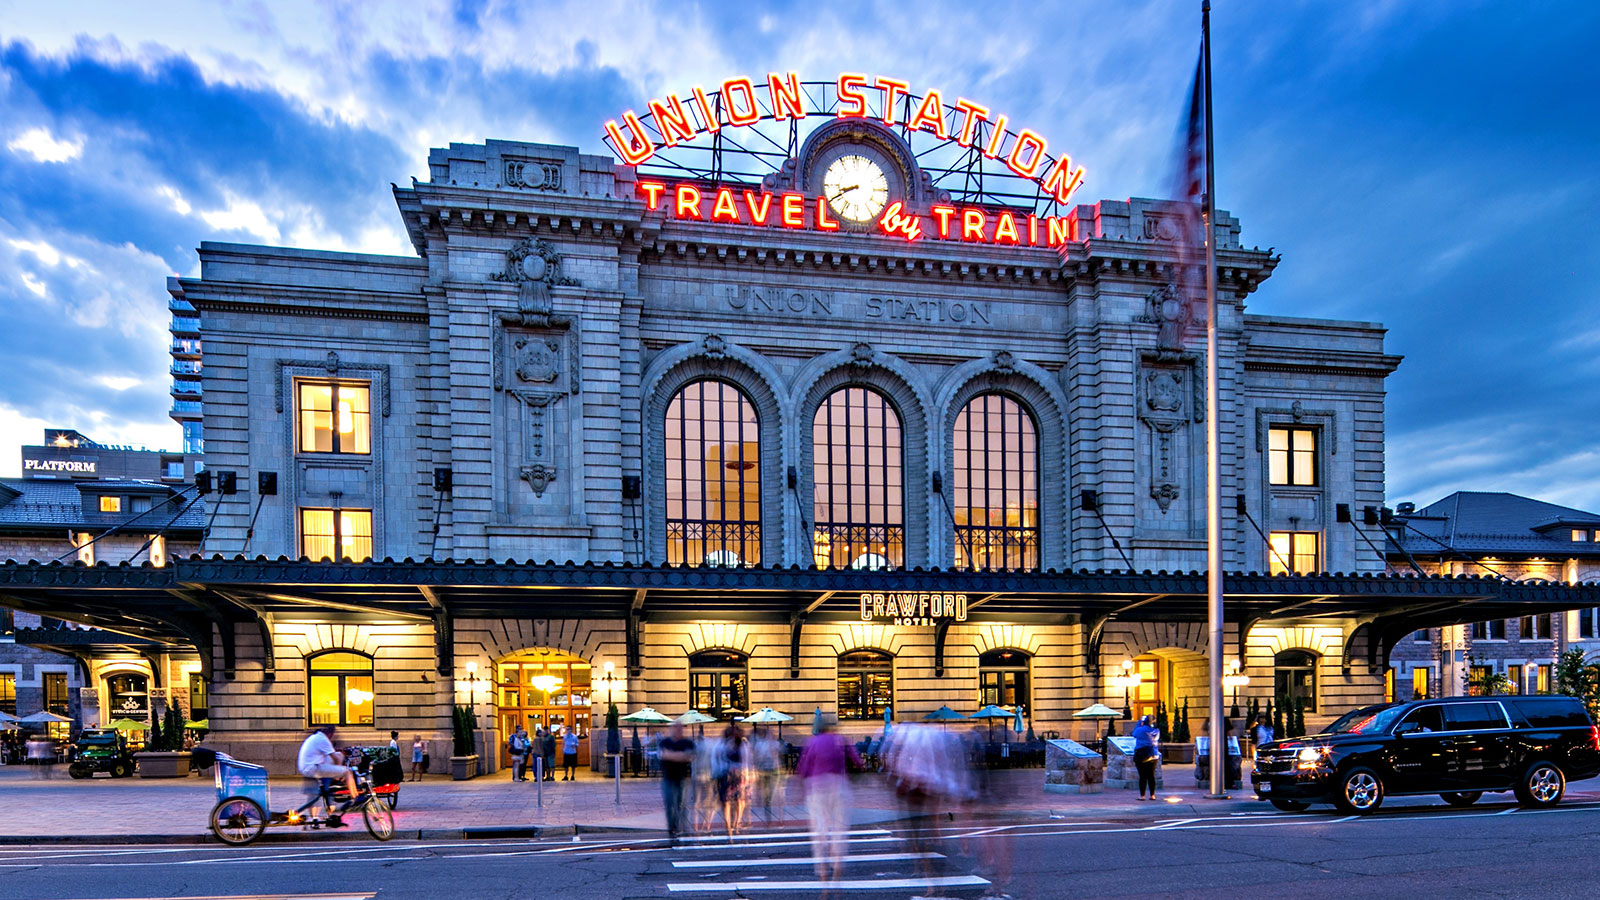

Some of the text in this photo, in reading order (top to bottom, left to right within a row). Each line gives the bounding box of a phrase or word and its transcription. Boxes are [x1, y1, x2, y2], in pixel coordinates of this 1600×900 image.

[603, 70, 1087, 205] UNION STATION
[637, 181, 1070, 247] TRAVEL by TRAIN
[725, 287, 992, 325] UNION STATION
[24, 459, 96, 473] PLATFORM
[860, 593, 967, 622] CRAWFORD
[893, 617, 937, 627] HOTEL
